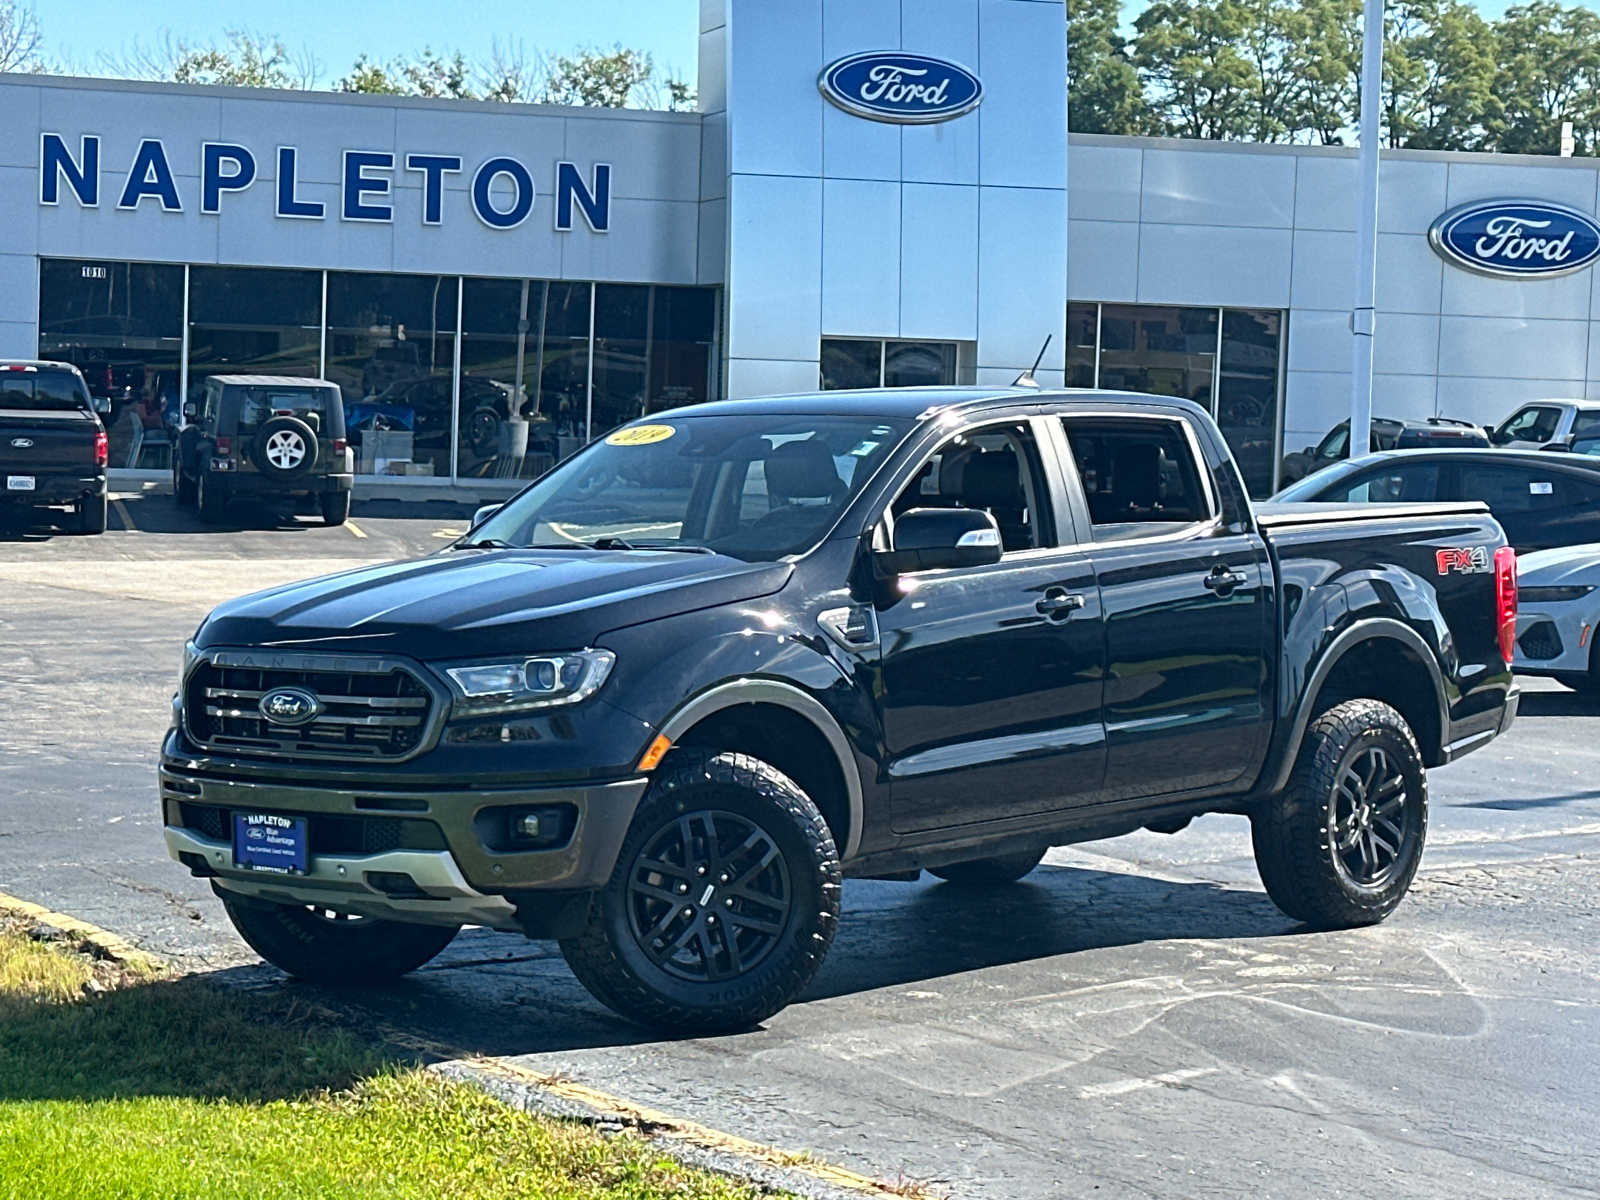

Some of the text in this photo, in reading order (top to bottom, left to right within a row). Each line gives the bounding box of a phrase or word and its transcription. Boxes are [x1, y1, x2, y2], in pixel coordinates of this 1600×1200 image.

[860, 64, 951, 104] Ford
[39, 132, 611, 233] NAPLETON
[1475, 216, 1575, 261] Ford
[82, 266, 106, 279] 1010
[1435, 546, 1489, 576] FX4
[216, 653, 379, 672] RANGER
[268, 694, 300, 715] Ford
[248, 814, 291, 829] NAPLETON
